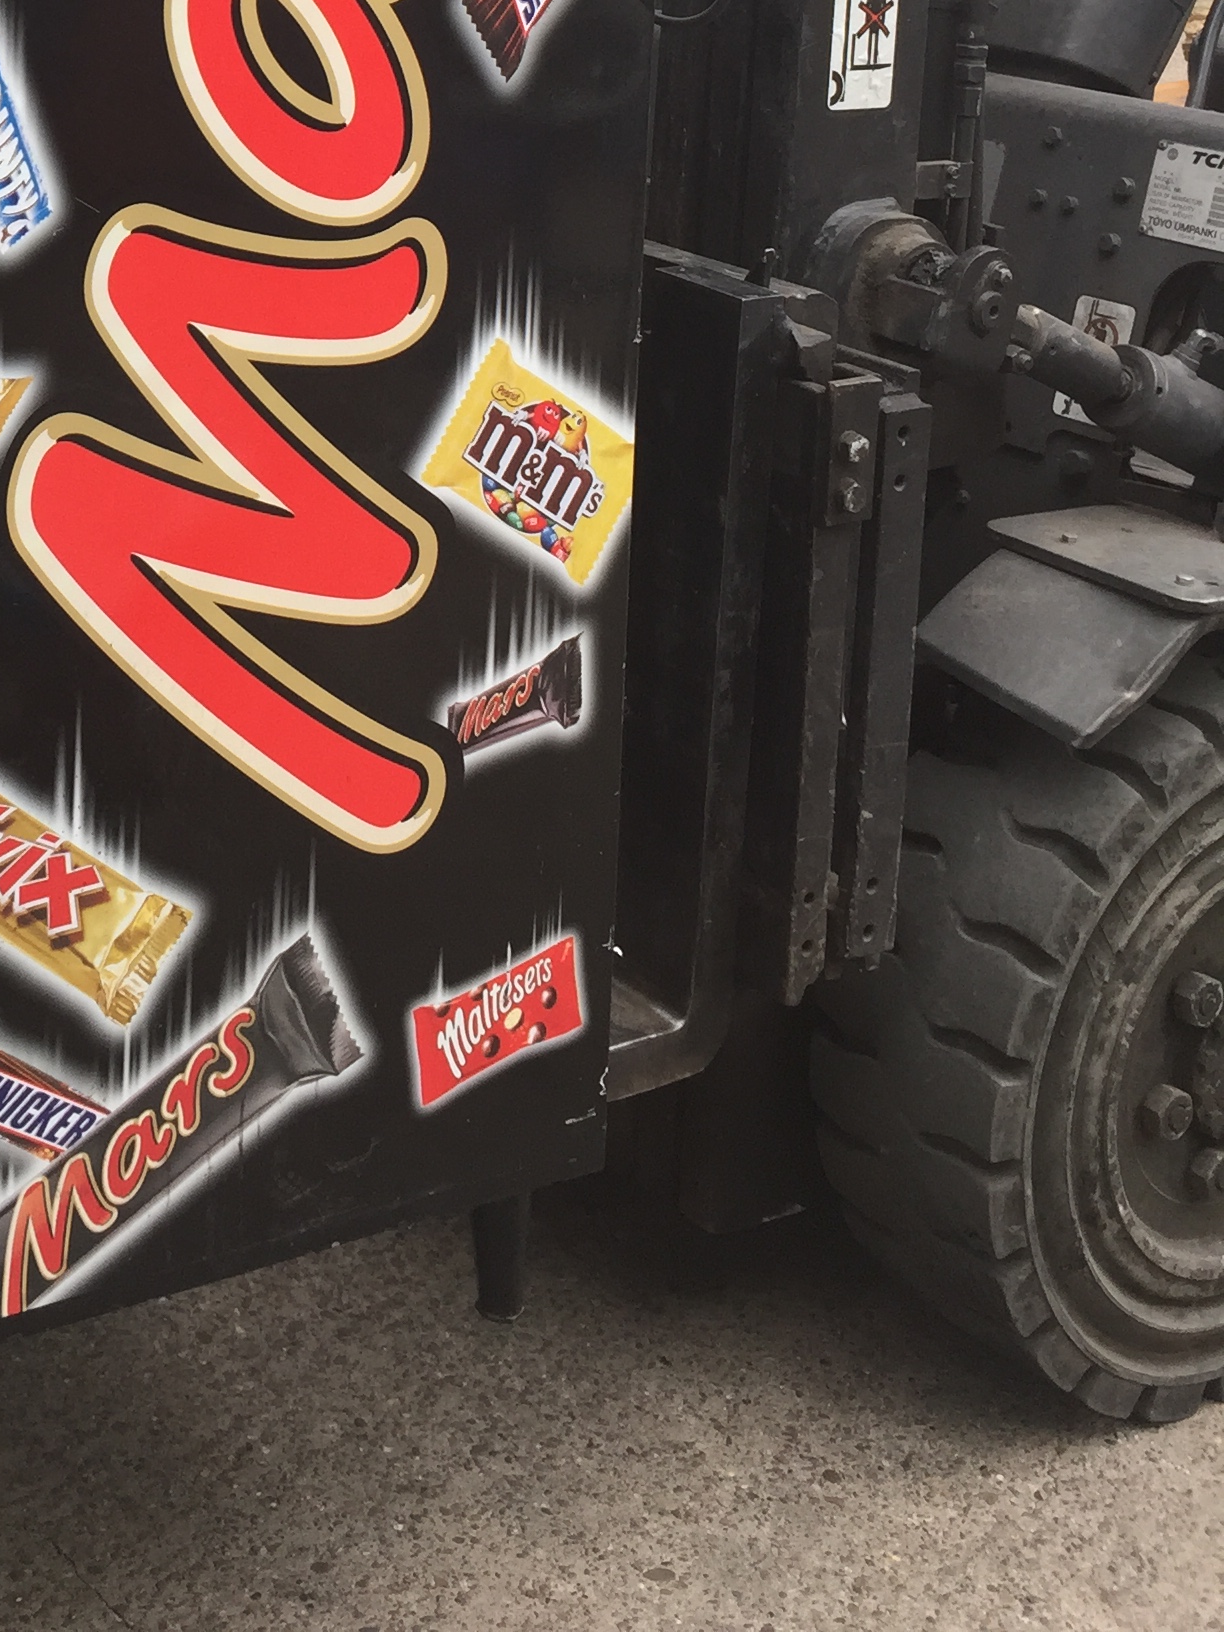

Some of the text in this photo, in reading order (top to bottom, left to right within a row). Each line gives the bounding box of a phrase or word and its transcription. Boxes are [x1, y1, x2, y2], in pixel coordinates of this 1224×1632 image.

[1148, 215, 1172, 229] TOYO
[458, 663, 542, 745] Mars
[437, 954, 553, 1079] Maltesers
[2, 1006, 256, 1317] Mars
